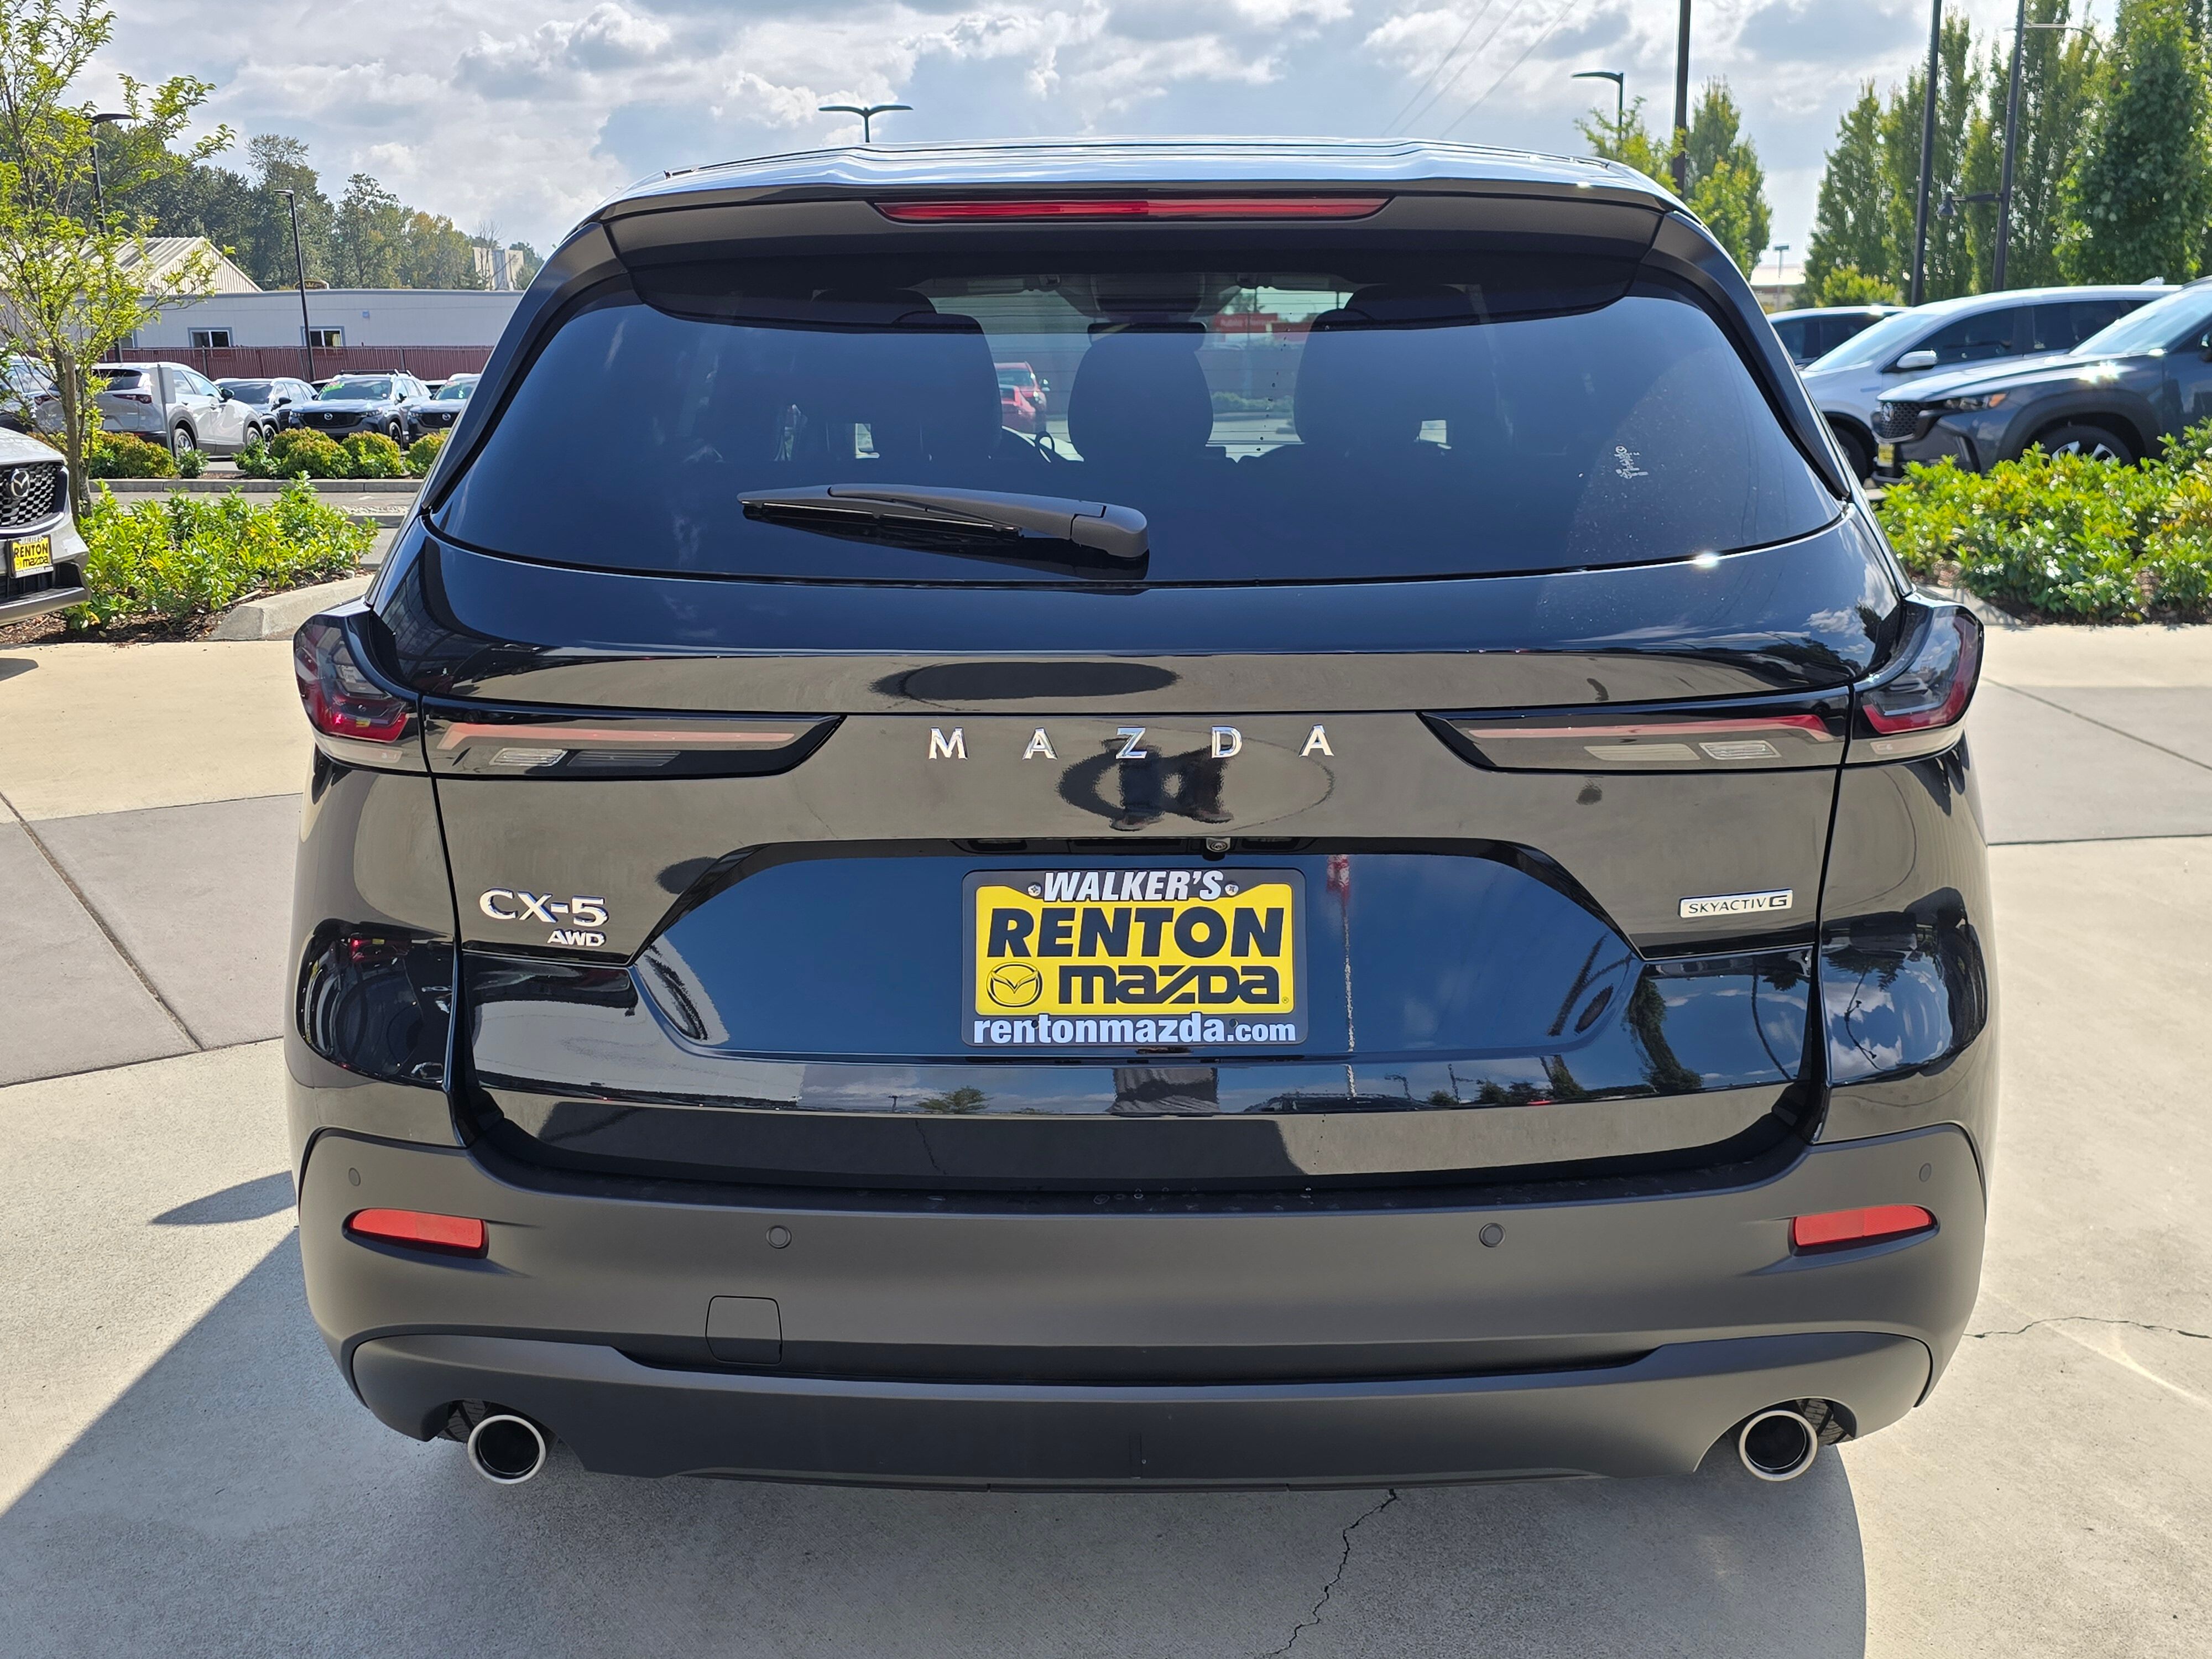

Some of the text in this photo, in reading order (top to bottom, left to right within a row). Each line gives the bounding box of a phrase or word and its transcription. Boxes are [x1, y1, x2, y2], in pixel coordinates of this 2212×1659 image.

[14, 543, 48, 558] RENTON
[928, 725, 1334, 760] MAZDA
[1044, 870, 1224, 902] WALKER'S
[479, 888, 609, 927] CX-5
[547, 928, 607, 947] AWD
[987, 906, 1285, 958] RENTON
[1058, 965, 1279, 1004] mazda
[974, 1013, 1295, 1044] rentonmazda.com
